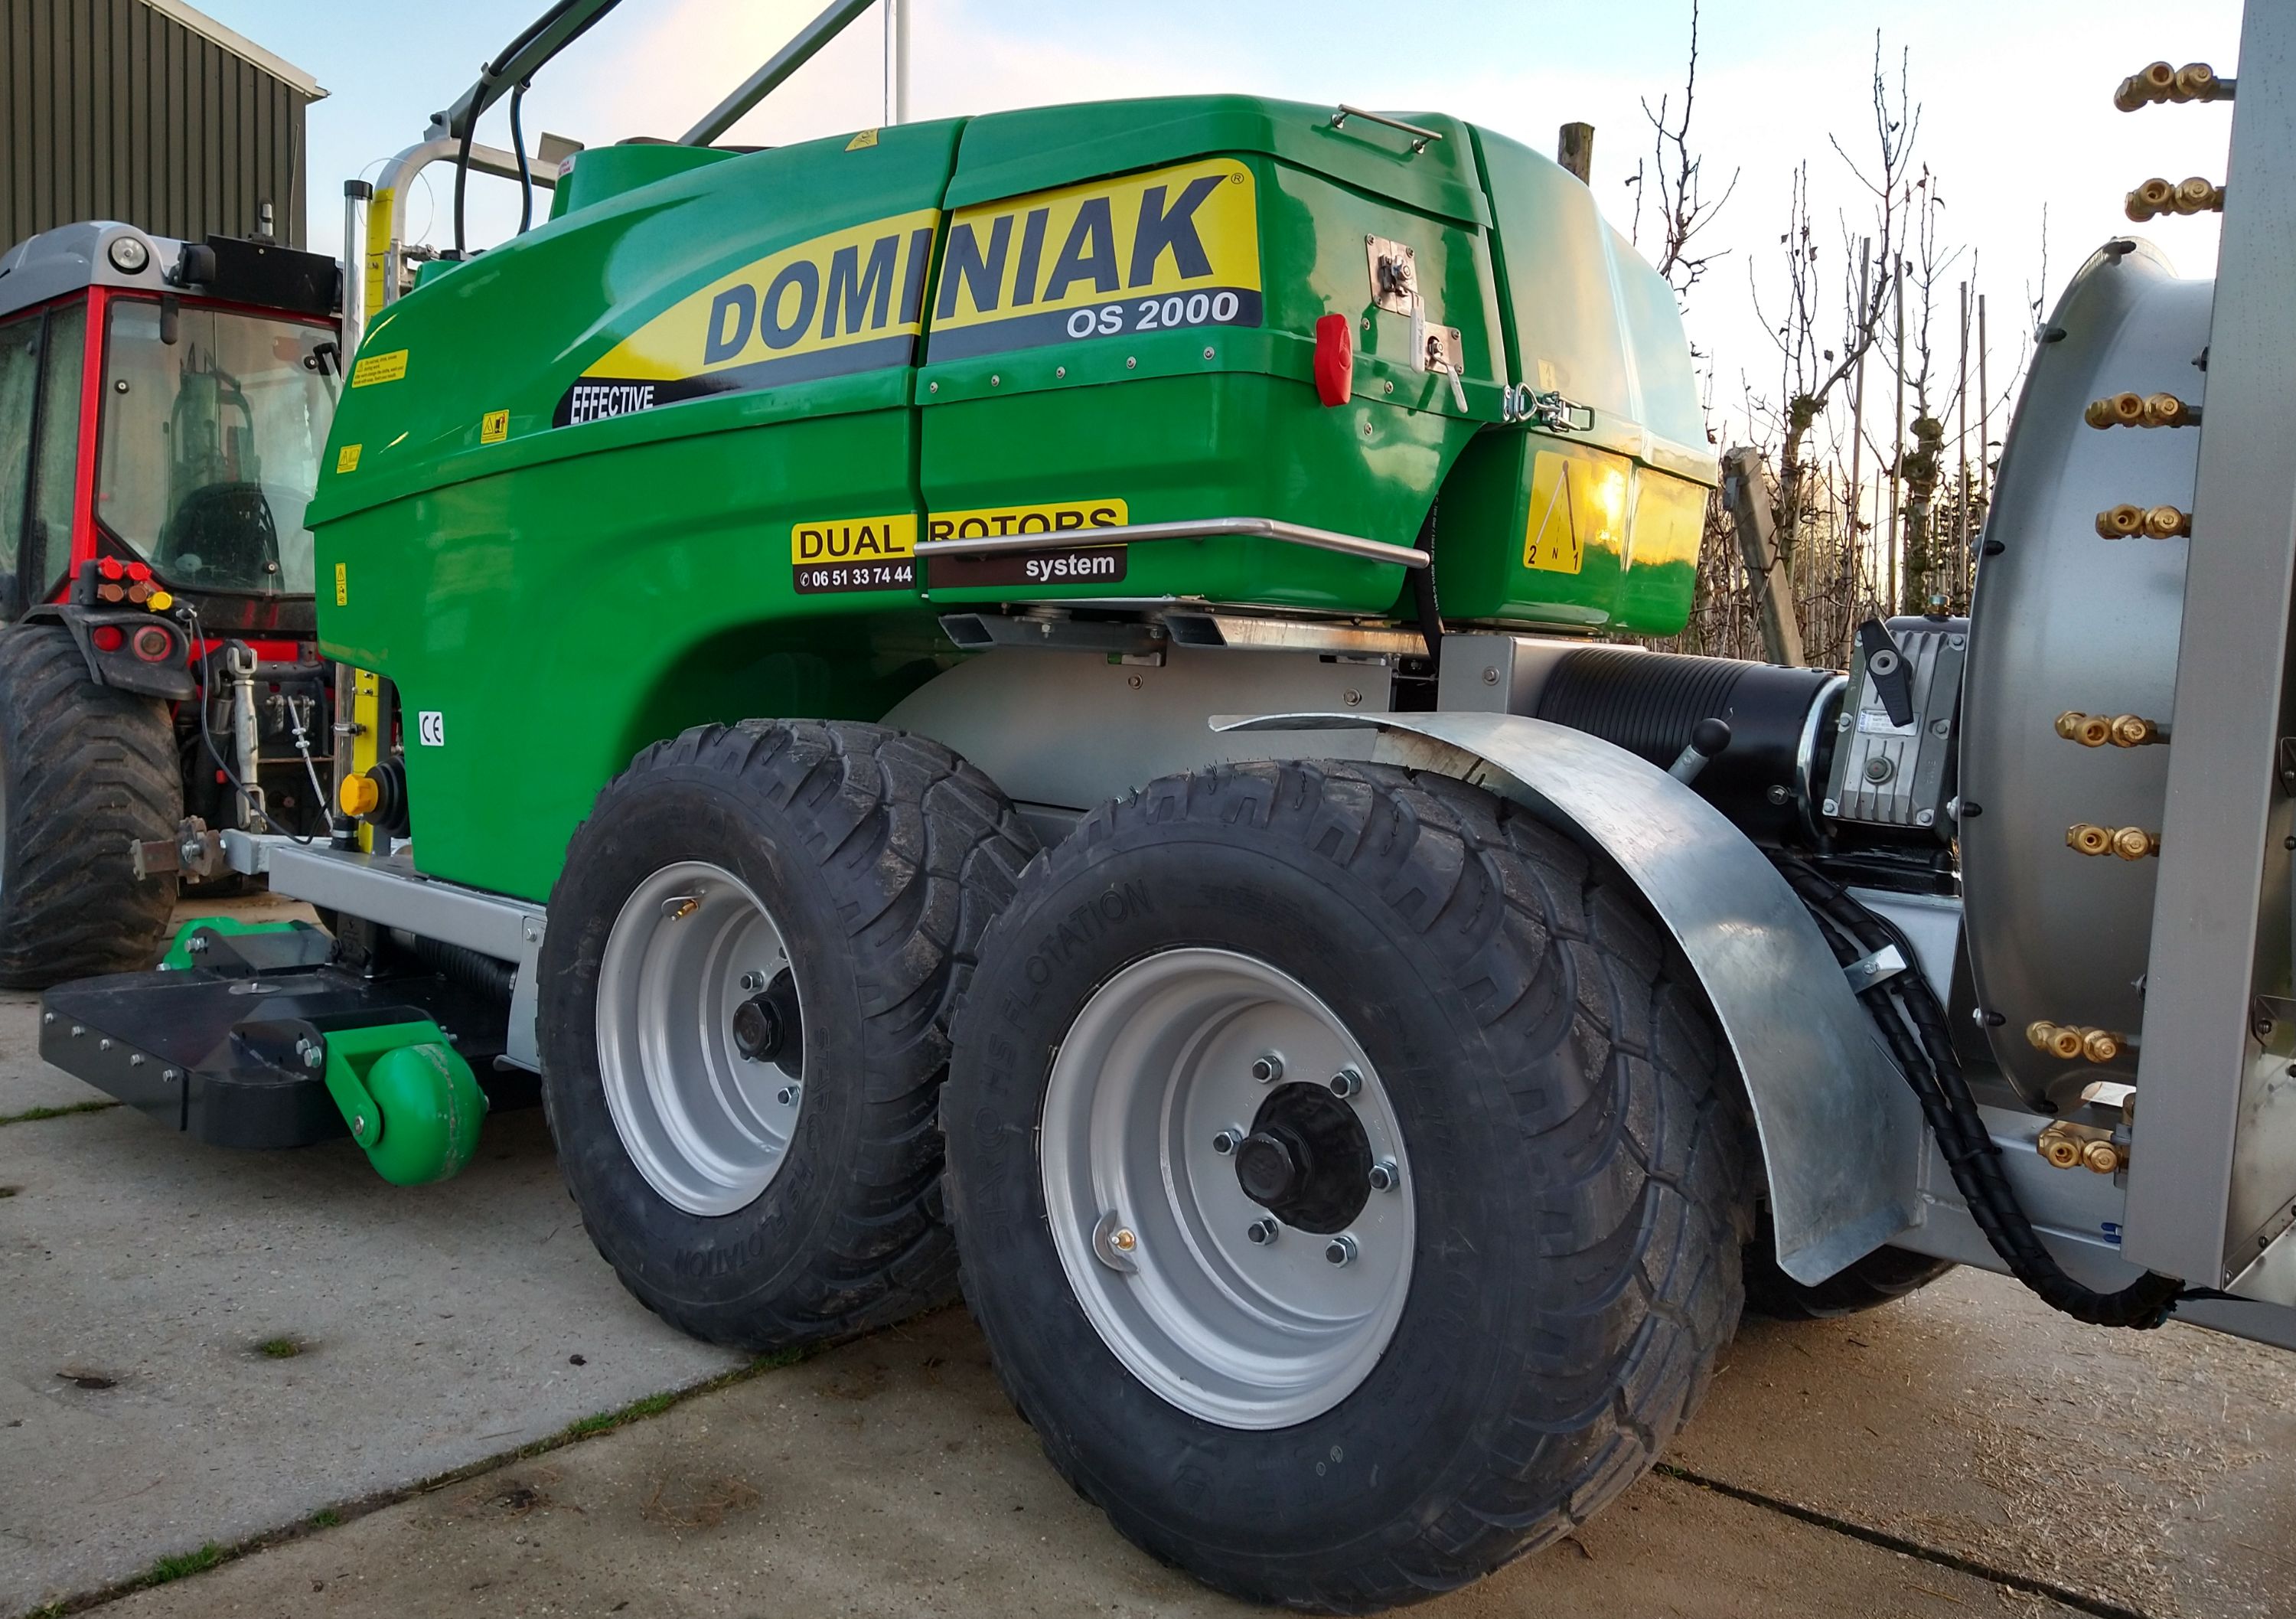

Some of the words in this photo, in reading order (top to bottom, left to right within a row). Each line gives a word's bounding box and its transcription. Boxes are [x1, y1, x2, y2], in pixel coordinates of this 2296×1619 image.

[703, 175, 1229, 365] DOMINIAK
[1067, 305, 1124, 338] OS
[1136, 292, 1239, 331] 2000
[570, 385, 654, 424] EFFECTIVE
[800, 524, 905, 559] DUAL
[930, 508, 1117, 541] ROTORS
[1528, 544, 1537, 564] 2
[1551, 547, 1559, 560] N
[1573, 551, 1579, 570] 1
[812, 571, 829, 587] 06
[832, 569, 847, 586] 51
[852, 568, 869, 585] 33
[872, 566, 891, 583] 74
[894, 566, 912, 583] 44
[1026, 554, 1115, 582] system
[422, 715, 442, 743] CE
[1001, 878, 1155, 1035] FLOTATION
